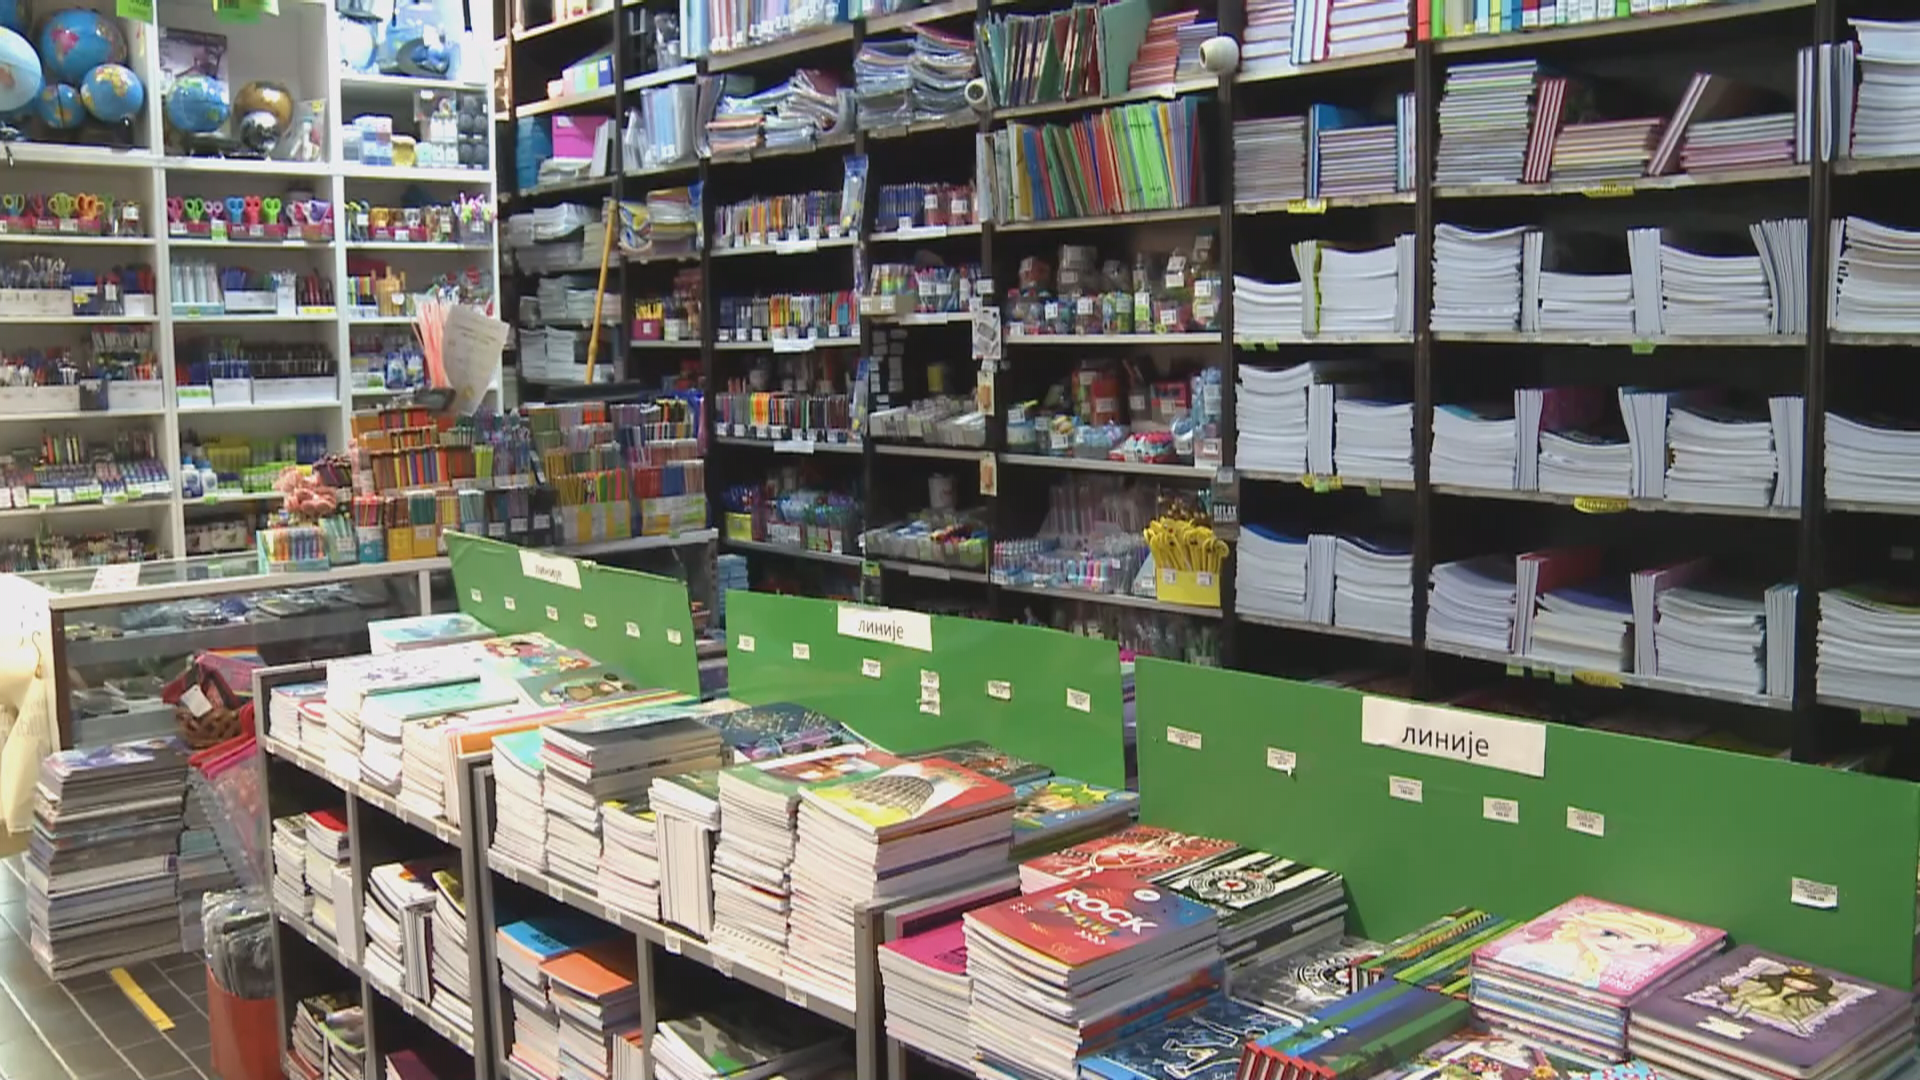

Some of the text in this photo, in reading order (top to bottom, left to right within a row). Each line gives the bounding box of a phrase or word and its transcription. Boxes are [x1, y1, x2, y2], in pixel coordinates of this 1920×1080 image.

[858, 619, 905, 642] линије
[1402, 726, 1490, 760] линије
[1055, 888, 1158, 935] ROCK
